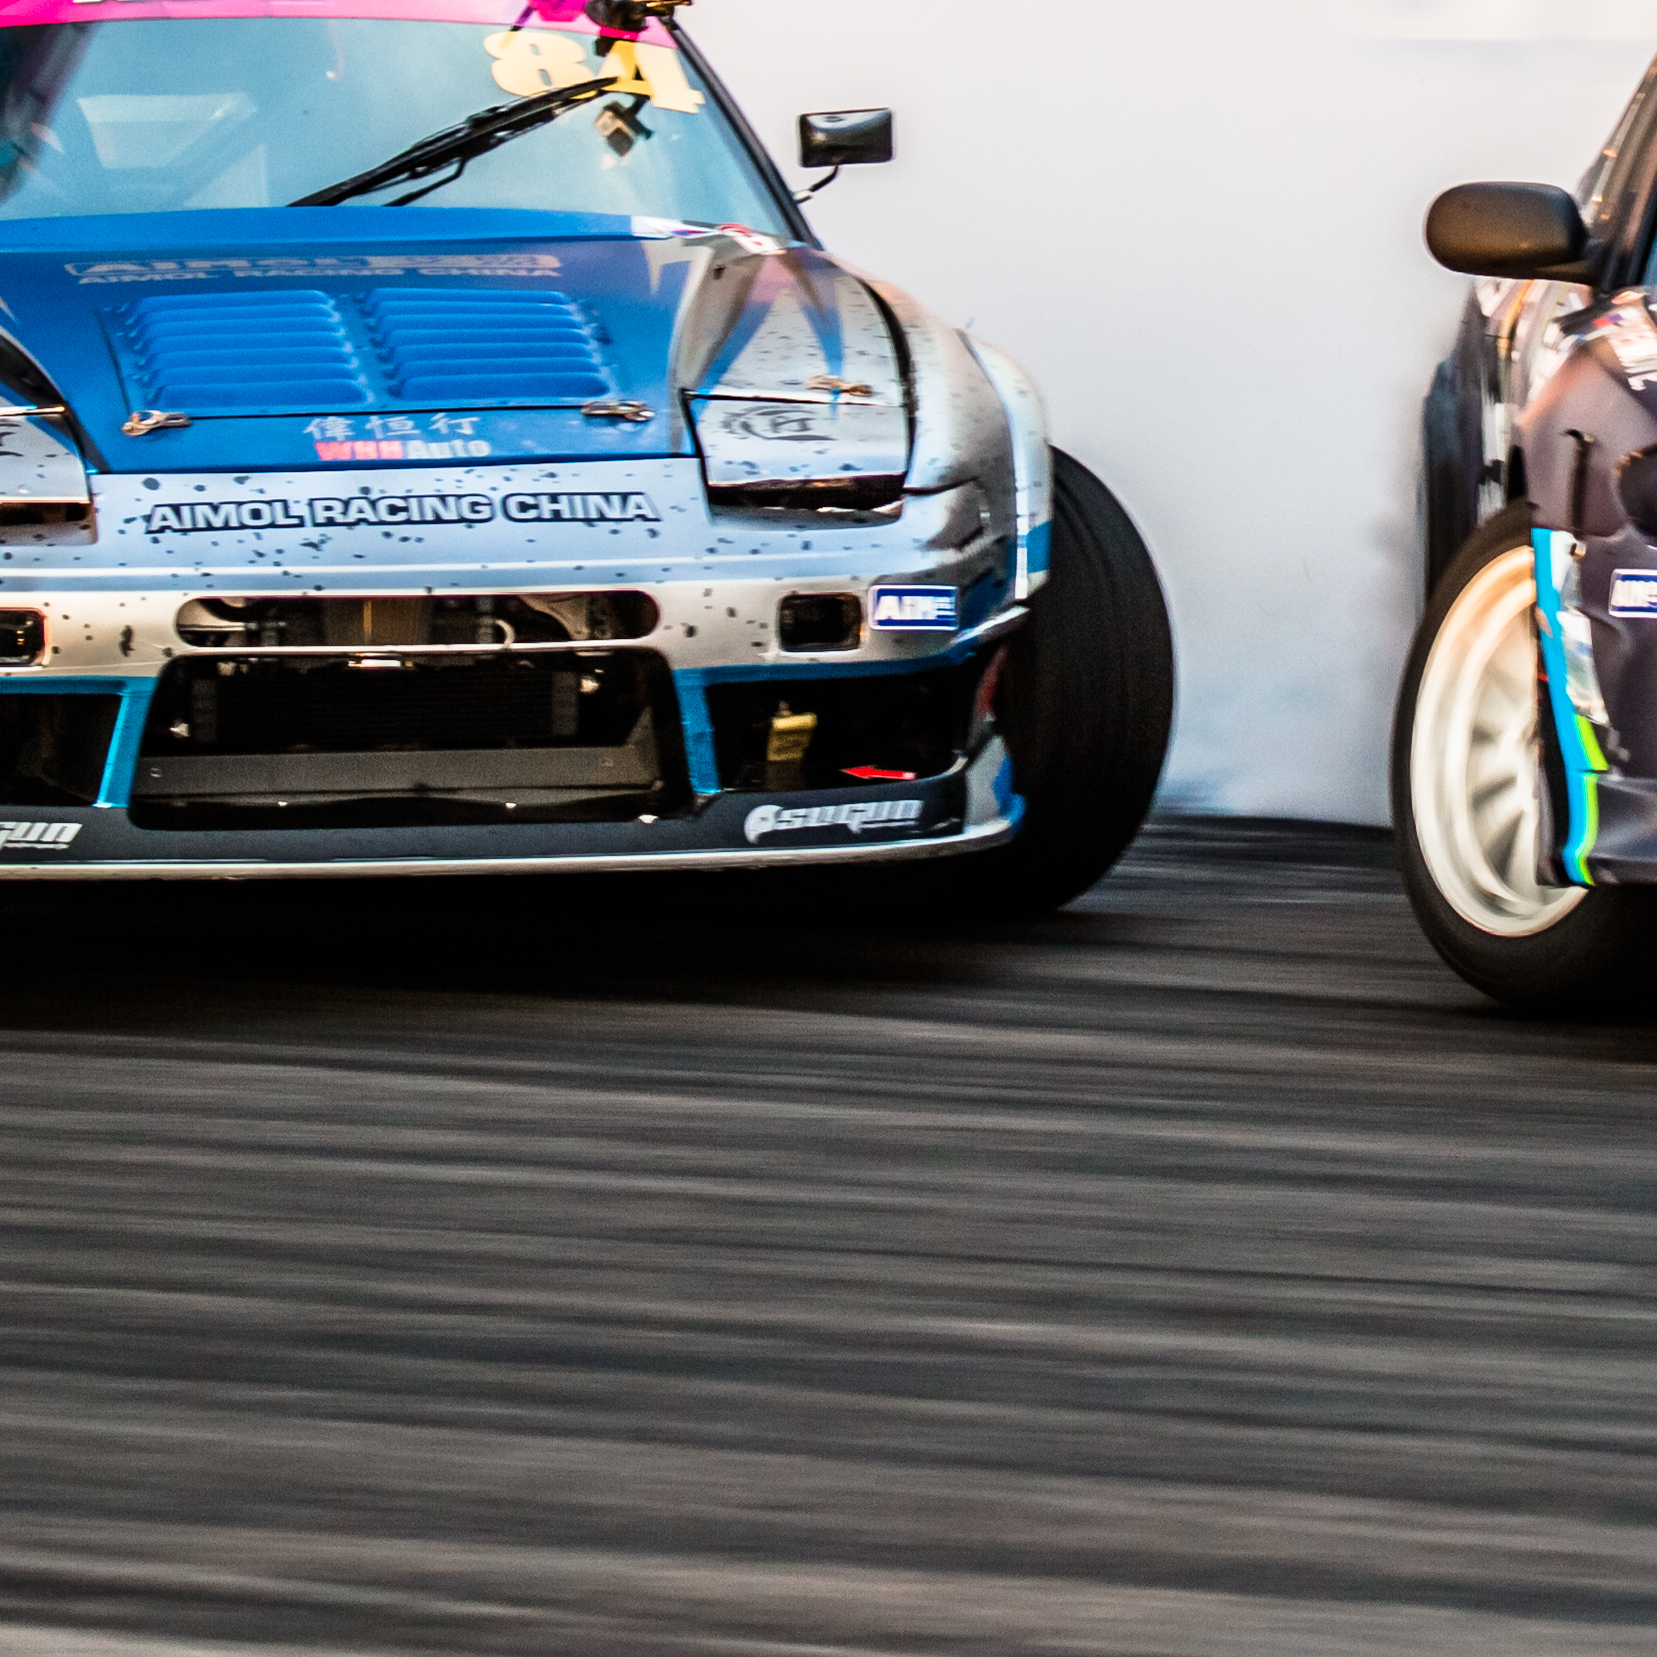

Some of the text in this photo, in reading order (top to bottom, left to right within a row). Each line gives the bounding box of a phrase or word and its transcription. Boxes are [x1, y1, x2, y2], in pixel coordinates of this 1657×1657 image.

[143, 492, 660, 532] AIMOL RACING CHINA
